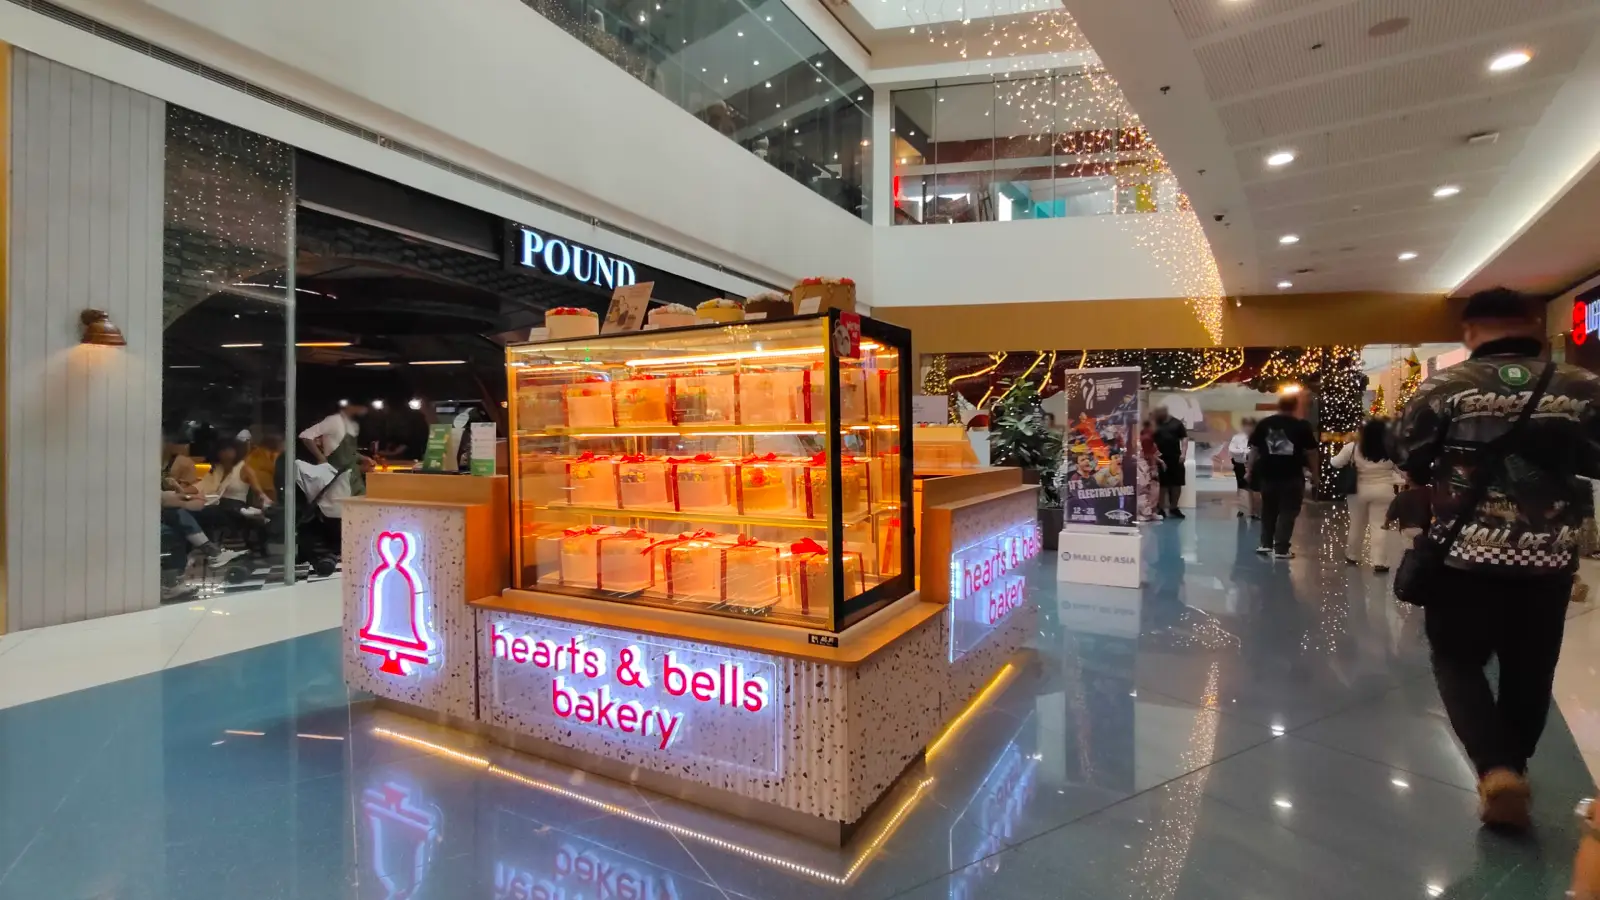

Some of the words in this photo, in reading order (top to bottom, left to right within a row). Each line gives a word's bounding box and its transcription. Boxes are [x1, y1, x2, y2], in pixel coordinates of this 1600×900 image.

[520, 228, 636, 290] POUND
[963, 544, 1006, 600] hearts
[1072, 553, 1098, 562] MALL
[1100, 555, 1112, 563] OF
[1113, 556, 1136, 565] ASIA
[490, 623, 603, 679] hearts
[615, 646, 647, 690] &
[663, 651, 766, 713] bells
[552, 676, 680, 751] bakery
